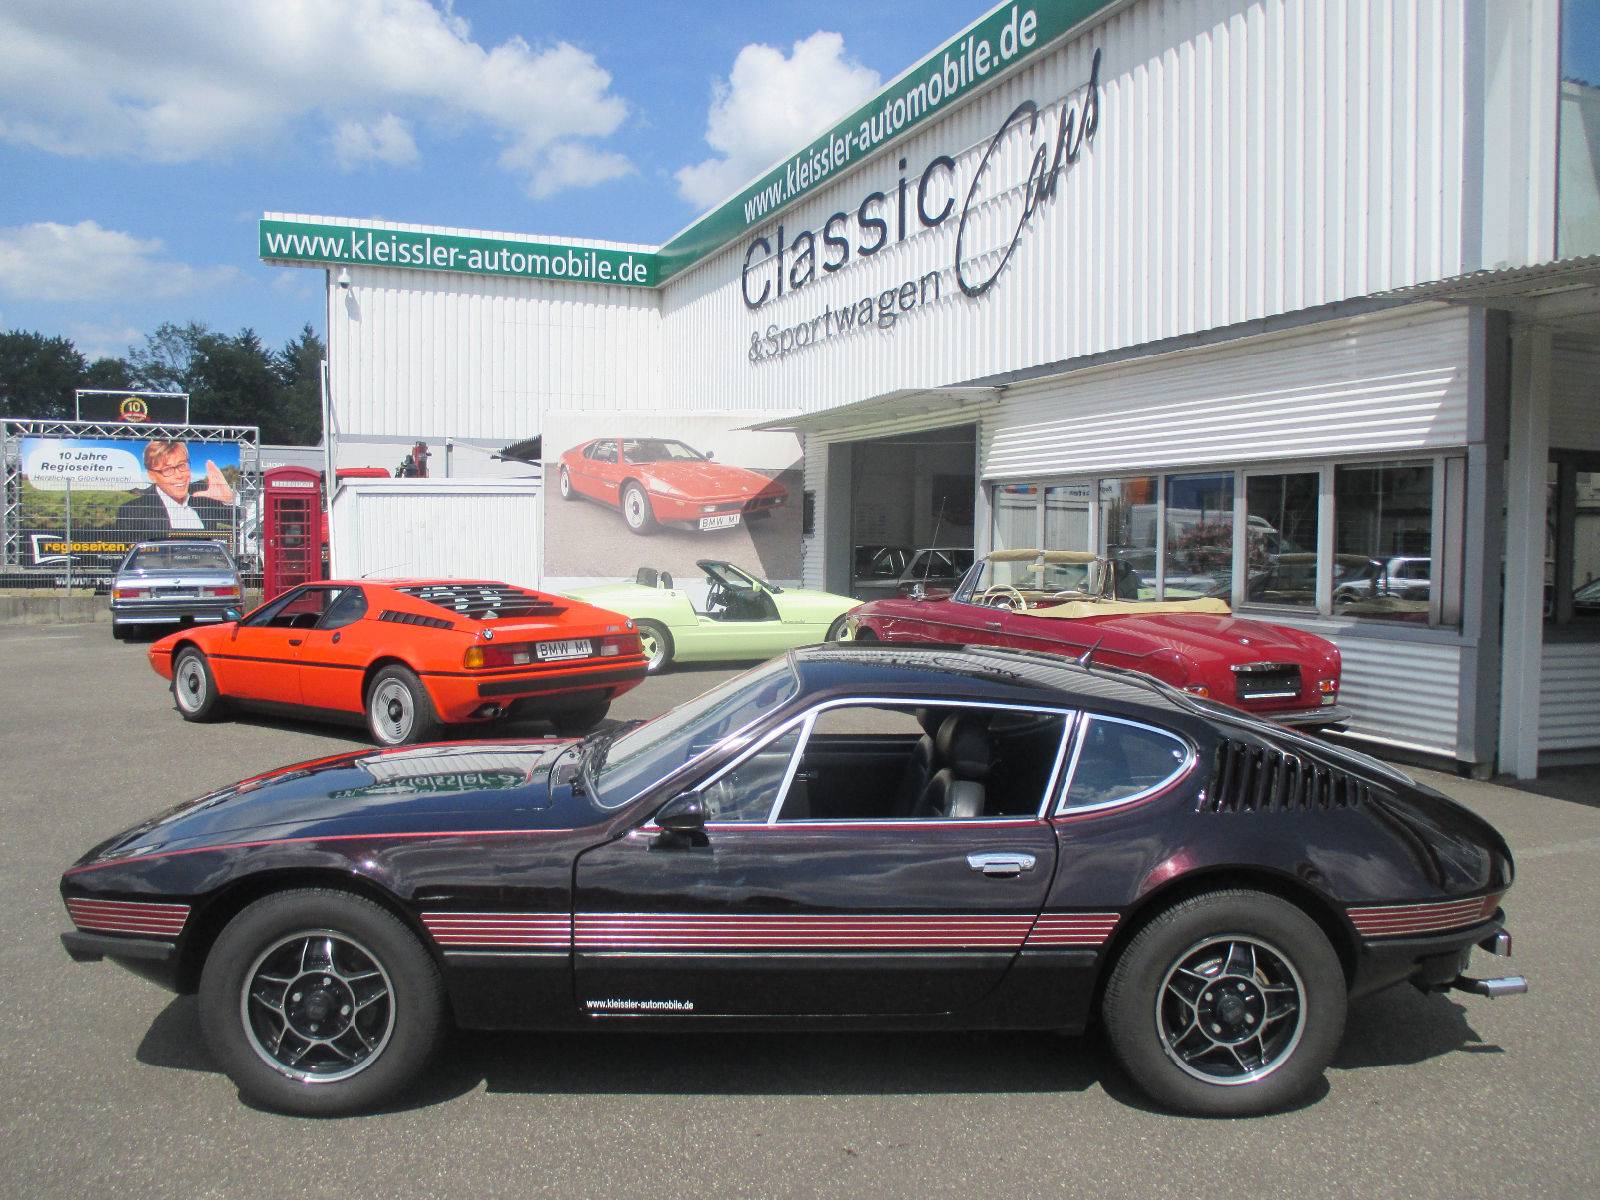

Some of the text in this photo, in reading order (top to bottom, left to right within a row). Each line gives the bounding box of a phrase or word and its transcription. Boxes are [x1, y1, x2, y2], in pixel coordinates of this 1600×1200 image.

[744, 5, 1037, 223] www.kleissler-automobile.de
[742, 48, 1101, 310] Classic Cars
[266, 230, 648, 283] www.kleissler-automobile.de
[59, 451, 108, 461] 10 Jahre
[41, 462, 113, 473] Regioseiten
[34, 473, 75, 482] Herzlichen
[701, 514, 740, 528] BMW M1
[539, 639, 591, 658] BMW M1
[586, 998, 694, 1010] www.kleissler-automobile.de
